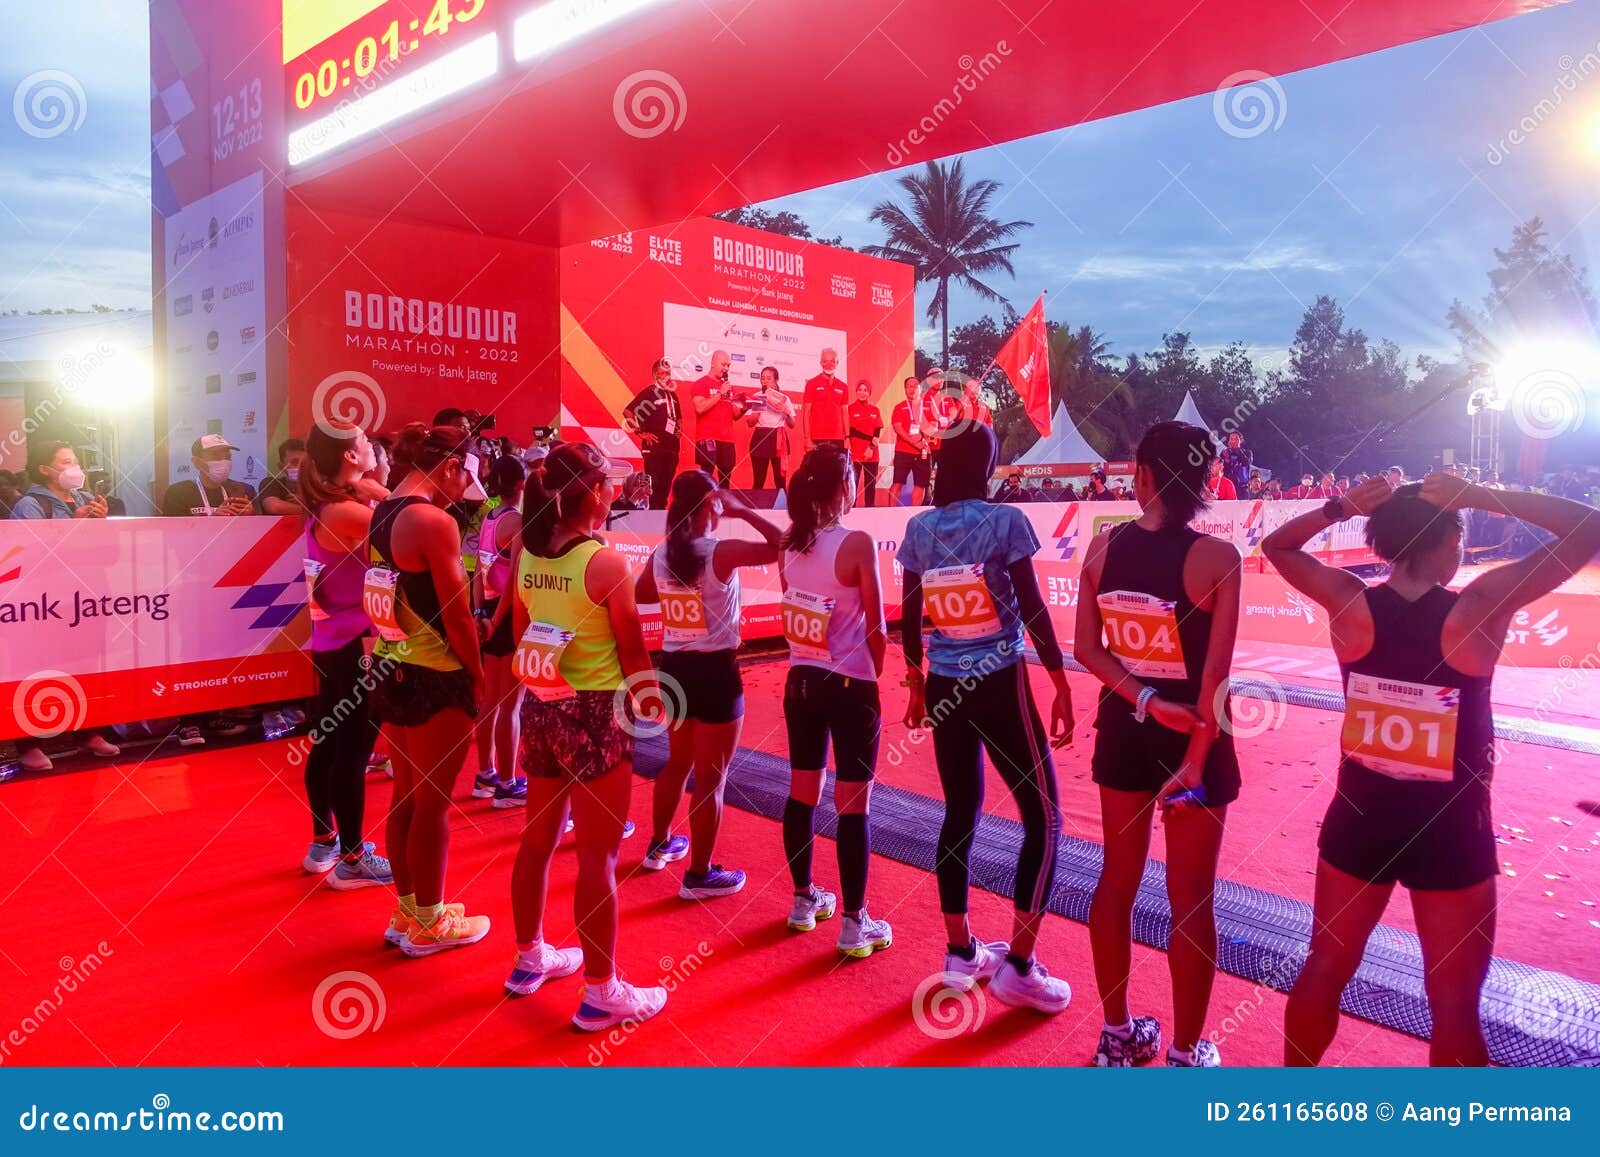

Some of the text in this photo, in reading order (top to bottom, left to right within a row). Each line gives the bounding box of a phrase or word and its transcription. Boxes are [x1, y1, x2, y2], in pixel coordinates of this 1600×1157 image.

[213, 78, 262, 139] 12-13
[214, 121, 262, 164] NOV 2022
[591, 239, 632, 254] NOV 2022
[649, 235, 681, 253] ELITE
[649, 247, 682, 266] RACE
[713, 236, 804, 278] BOROBUDUR
[714, 264, 805, 290] MARATHON 2022
[831, 278, 856, 291] YOUNG
[708, 296, 731, 308] TAMAN
[831, 287, 856, 300] TALENT
[871, 286, 893, 299] TILIK
[871, 297, 894, 308] CANDI
[345, 290, 517, 344] BOROBUDUR
[346, 334, 518, 363] MARATHON 2022
[372, 360, 498, 385] Powered by: Bank Jateng
[1023, 467, 1053, 477] MEDIS
[524, 573, 572, 593] SUMUT
[0, 591, 170, 628] ank Jateng
[365, 591, 392, 620] 109
[661, 599, 700, 622] 103
[928, 590, 990, 620] 102
[784, 610, 823, 643] 108
[1105, 617, 1176, 654] 104
[517, 647, 557, 681] 106
[173, 670, 289, 692] STRONGER TO VICTORY
[1355, 710, 1441, 758] 101
